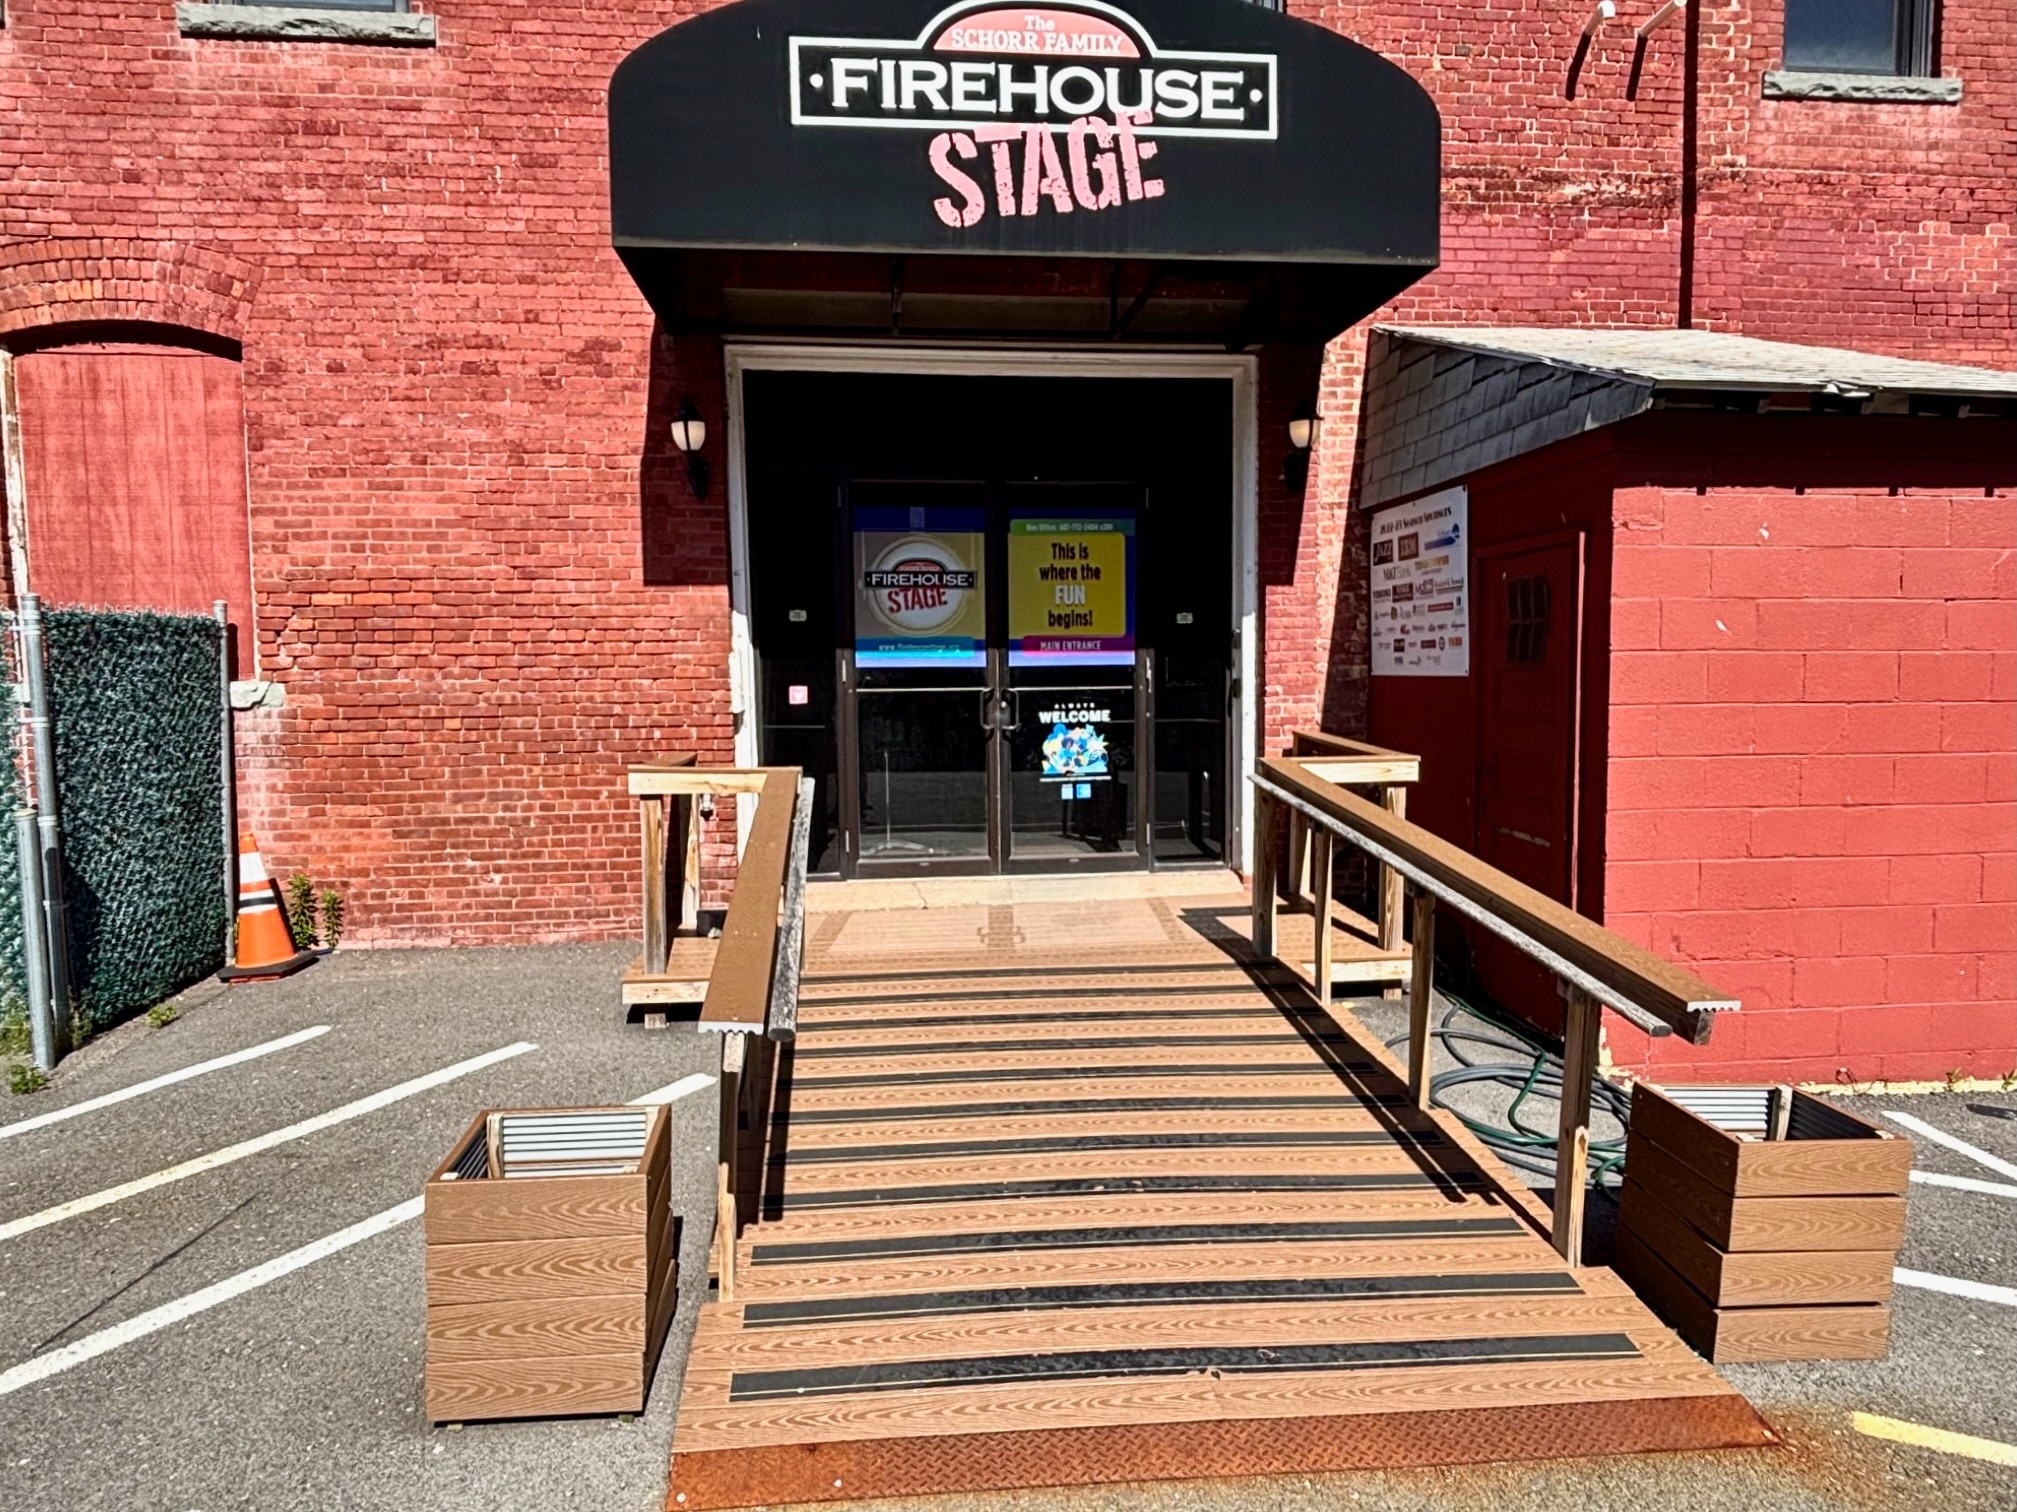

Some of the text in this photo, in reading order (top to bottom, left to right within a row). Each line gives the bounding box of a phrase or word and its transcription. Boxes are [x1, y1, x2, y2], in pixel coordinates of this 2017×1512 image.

[1023, 14, 1056, 32] The
[951, 28, 1124, 53] SCHORR FAMILY
[830, 57, 1245, 121] FIREHOUSE
[928, 109, 1166, 228] STAGE
[1051, 542, 1089, 560] This is
[871, 573, 968, 586] FIREHOUSE
[1039, 563, 1101, 580] where the
[887, 584, 948, 614] STAGE
[1055, 585, 1086, 606] FUN
[1048, 610, 1093, 629] begins!
[1040, 640, 1102, 651] MAIN ENTRANCE
[1038, 710, 1111, 724] WELCOME
